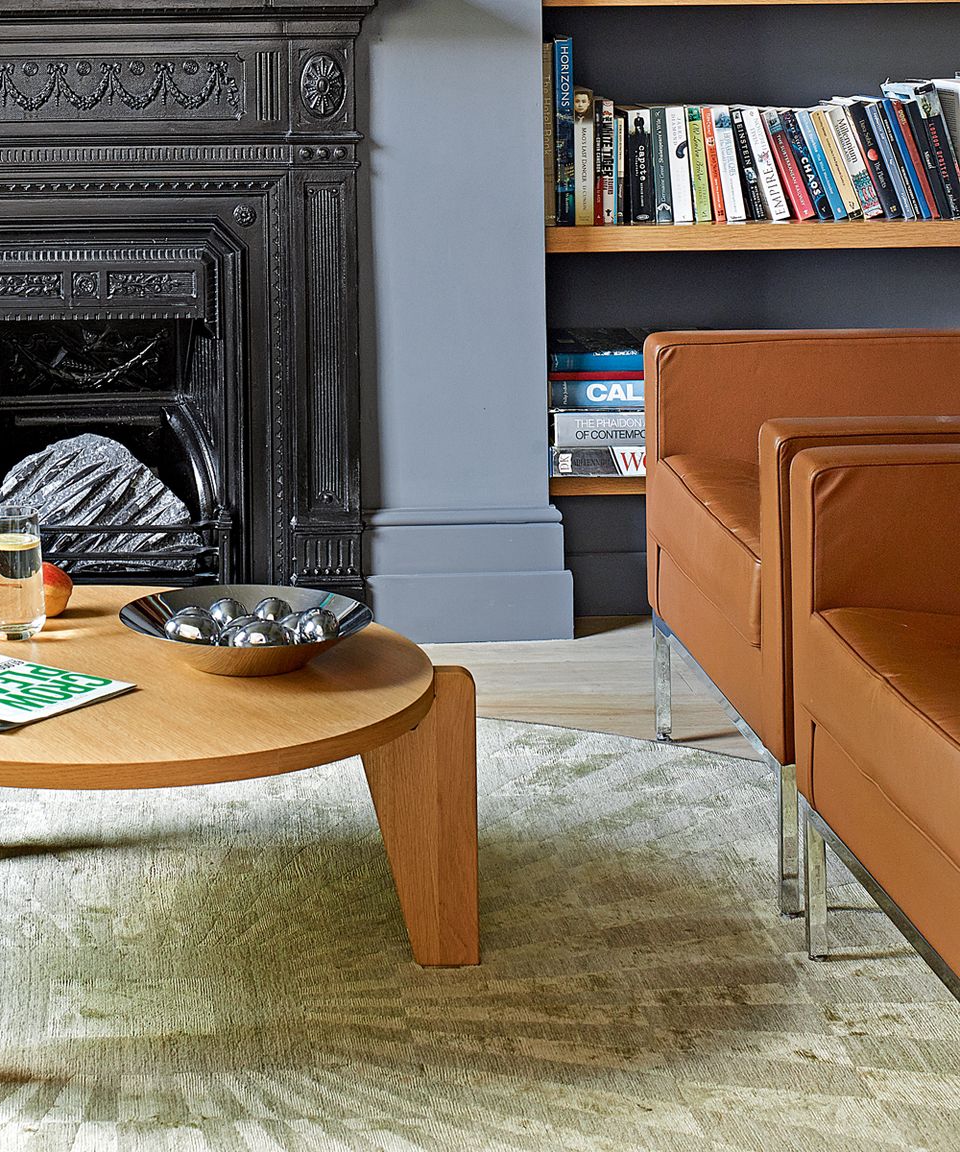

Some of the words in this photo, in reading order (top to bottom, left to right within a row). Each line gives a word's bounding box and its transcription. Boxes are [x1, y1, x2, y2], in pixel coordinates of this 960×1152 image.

[560, 45, 571, 107] HORIZONS
[638, 144, 649, 182] capote
[736, 123, 751, 166] EINSTEIN
[837, 118, 859, 165] Millennium
[763, 167, 787, 216] EMPIRE
[801, 156, 823, 197] CHAOS
[575, 419, 594, 428] THE
[596, 419, 642, 428] PHAIDON
